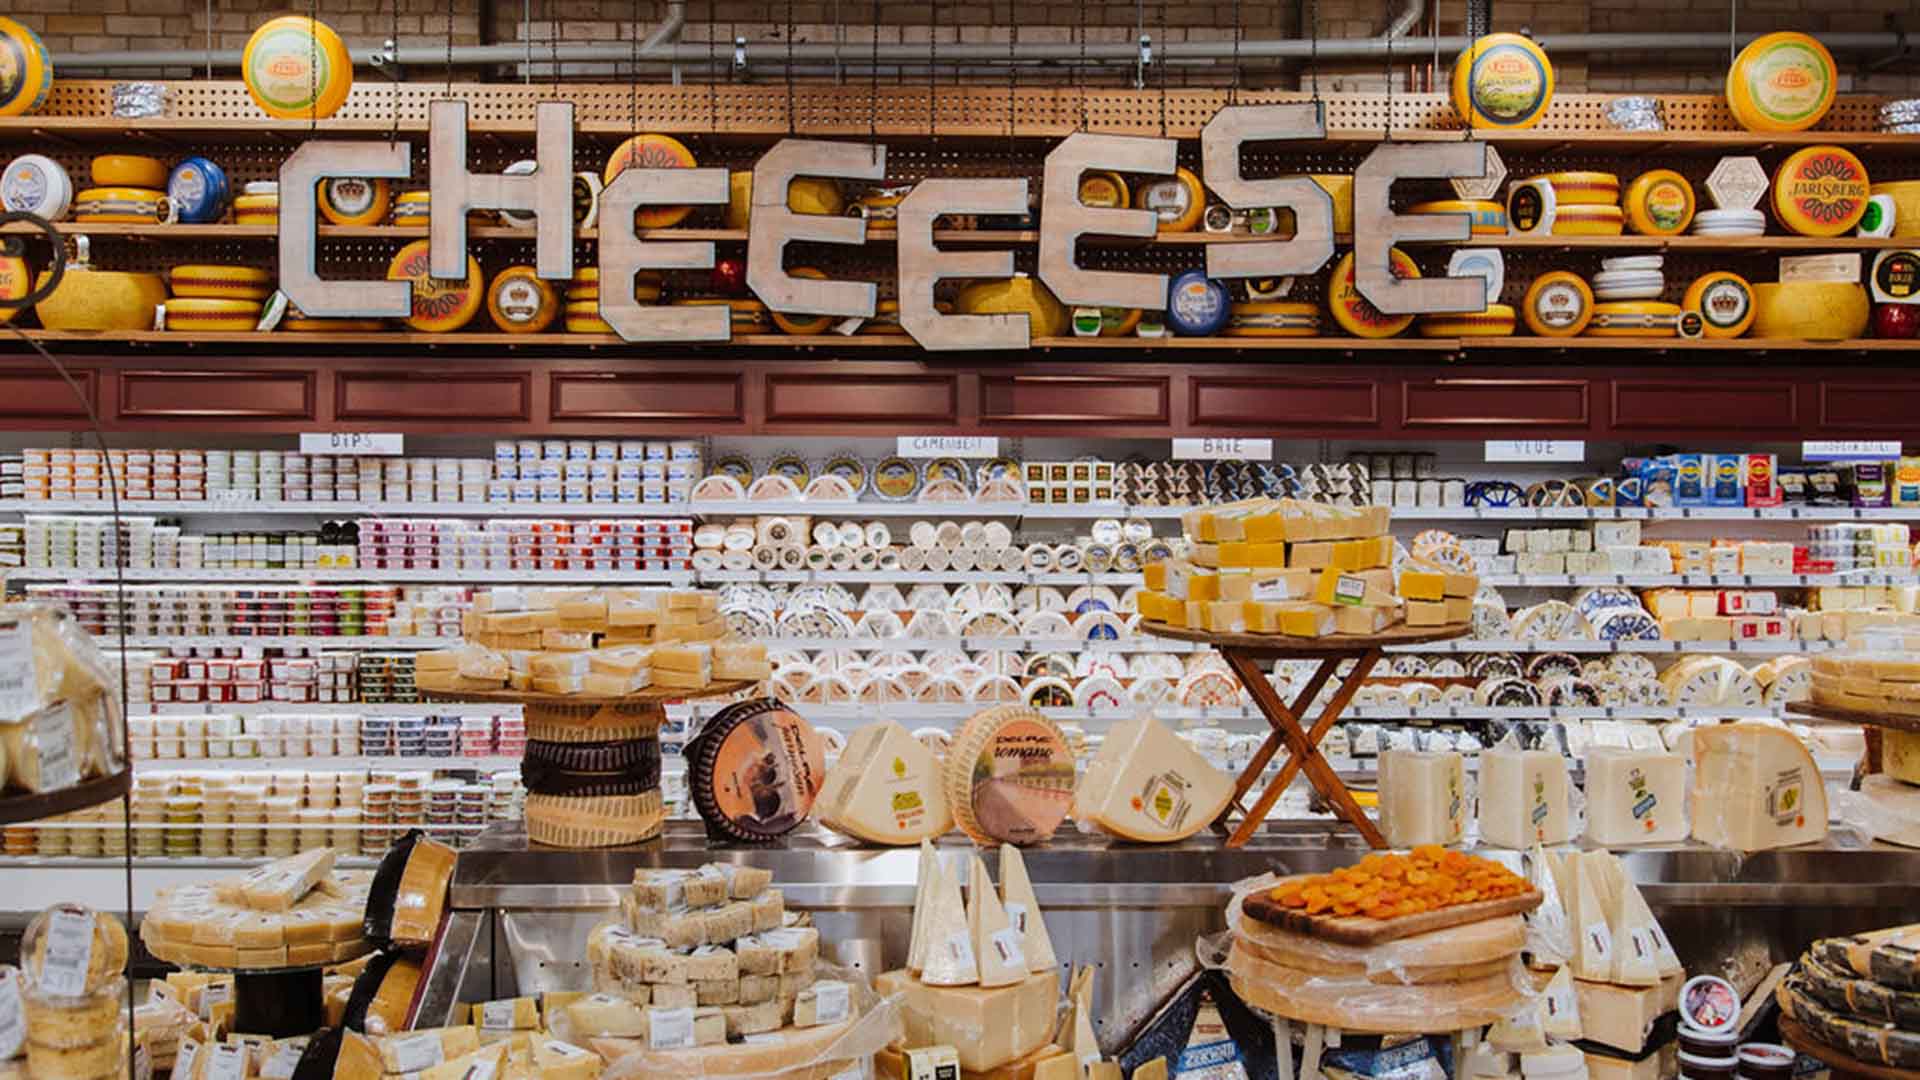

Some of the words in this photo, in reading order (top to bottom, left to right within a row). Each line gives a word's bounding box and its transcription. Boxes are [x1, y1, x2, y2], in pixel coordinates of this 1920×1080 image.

[1793, 182, 1865, 199] JARLSBERG
[278, 99, 1488, 352] CHEEEESE
[330, 433, 373, 448] DIPS
[1202, 437, 1243, 454] BRIE
[993, 745, 1054, 760] romano
